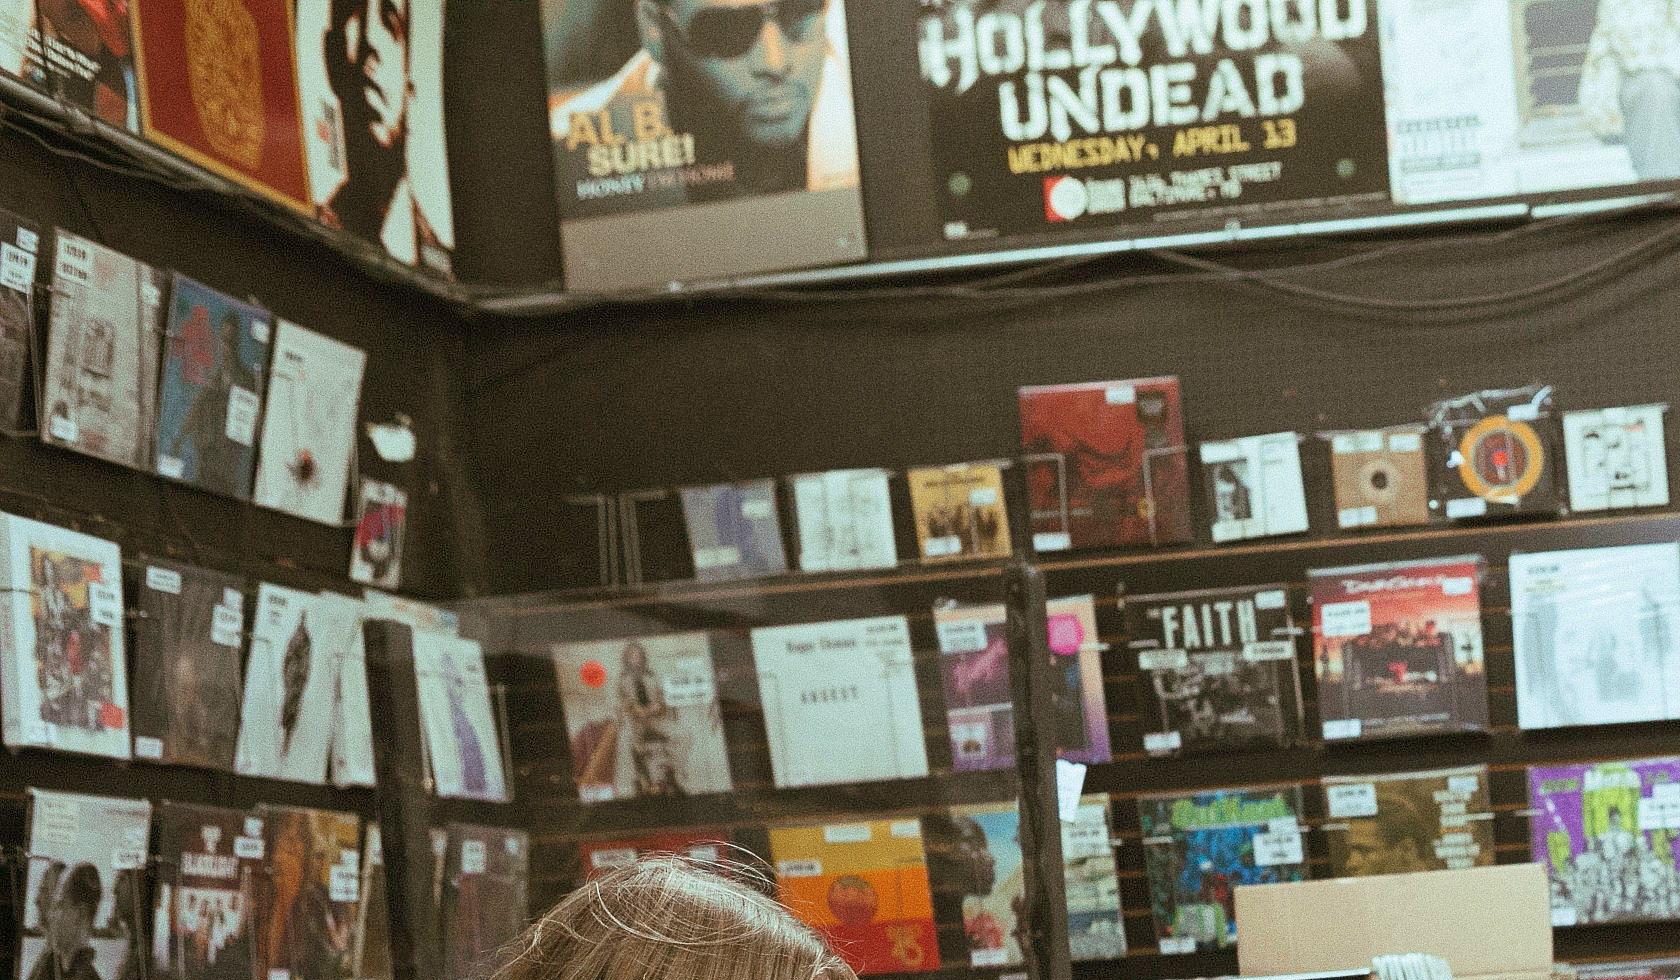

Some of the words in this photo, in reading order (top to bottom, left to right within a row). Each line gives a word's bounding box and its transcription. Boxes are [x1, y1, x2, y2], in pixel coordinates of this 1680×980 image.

[919, 0, 1367, 92] HOLLYWOOD
[1000, 52, 1305, 141] UNDEAD
[566, 108, 625, 151] AL
[1172, 126, 1251, 161] APRIL
[1263, 118, 1297, 149] 13
[587, 133, 695, 177] SURE!
[1161, 600, 1258, 650] FAITH
